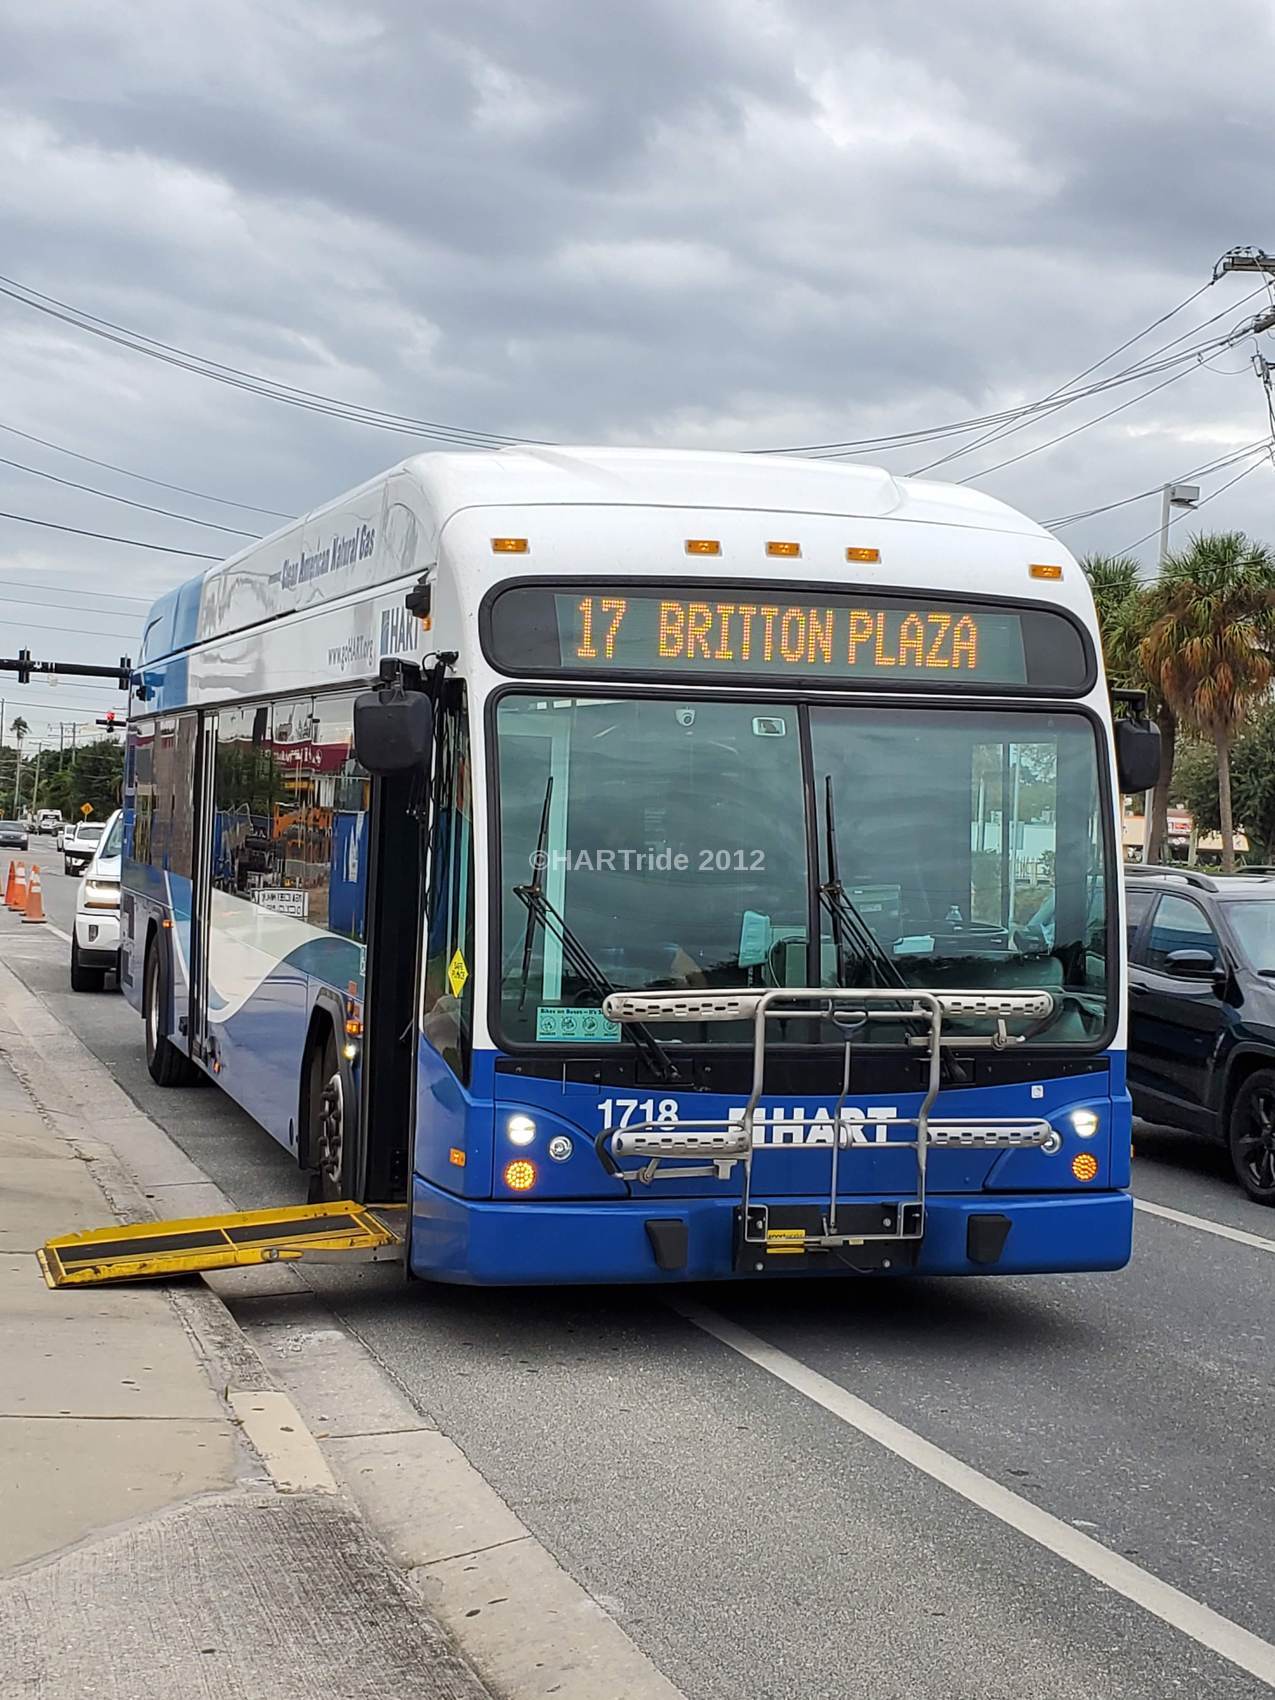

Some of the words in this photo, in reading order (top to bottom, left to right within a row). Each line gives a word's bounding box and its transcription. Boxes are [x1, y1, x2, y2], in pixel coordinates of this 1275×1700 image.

[330, 527, 360, 572] Natural
[359, 523, 375, 561] Gas
[576, 597, 626, 659] 17
[658, 602, 834, 664] BRITTON
[847, 610, 977, 669] PLAZA
[598, 1098, 679, 1131] 1718
[773, 1107, 898, 1144] HART
